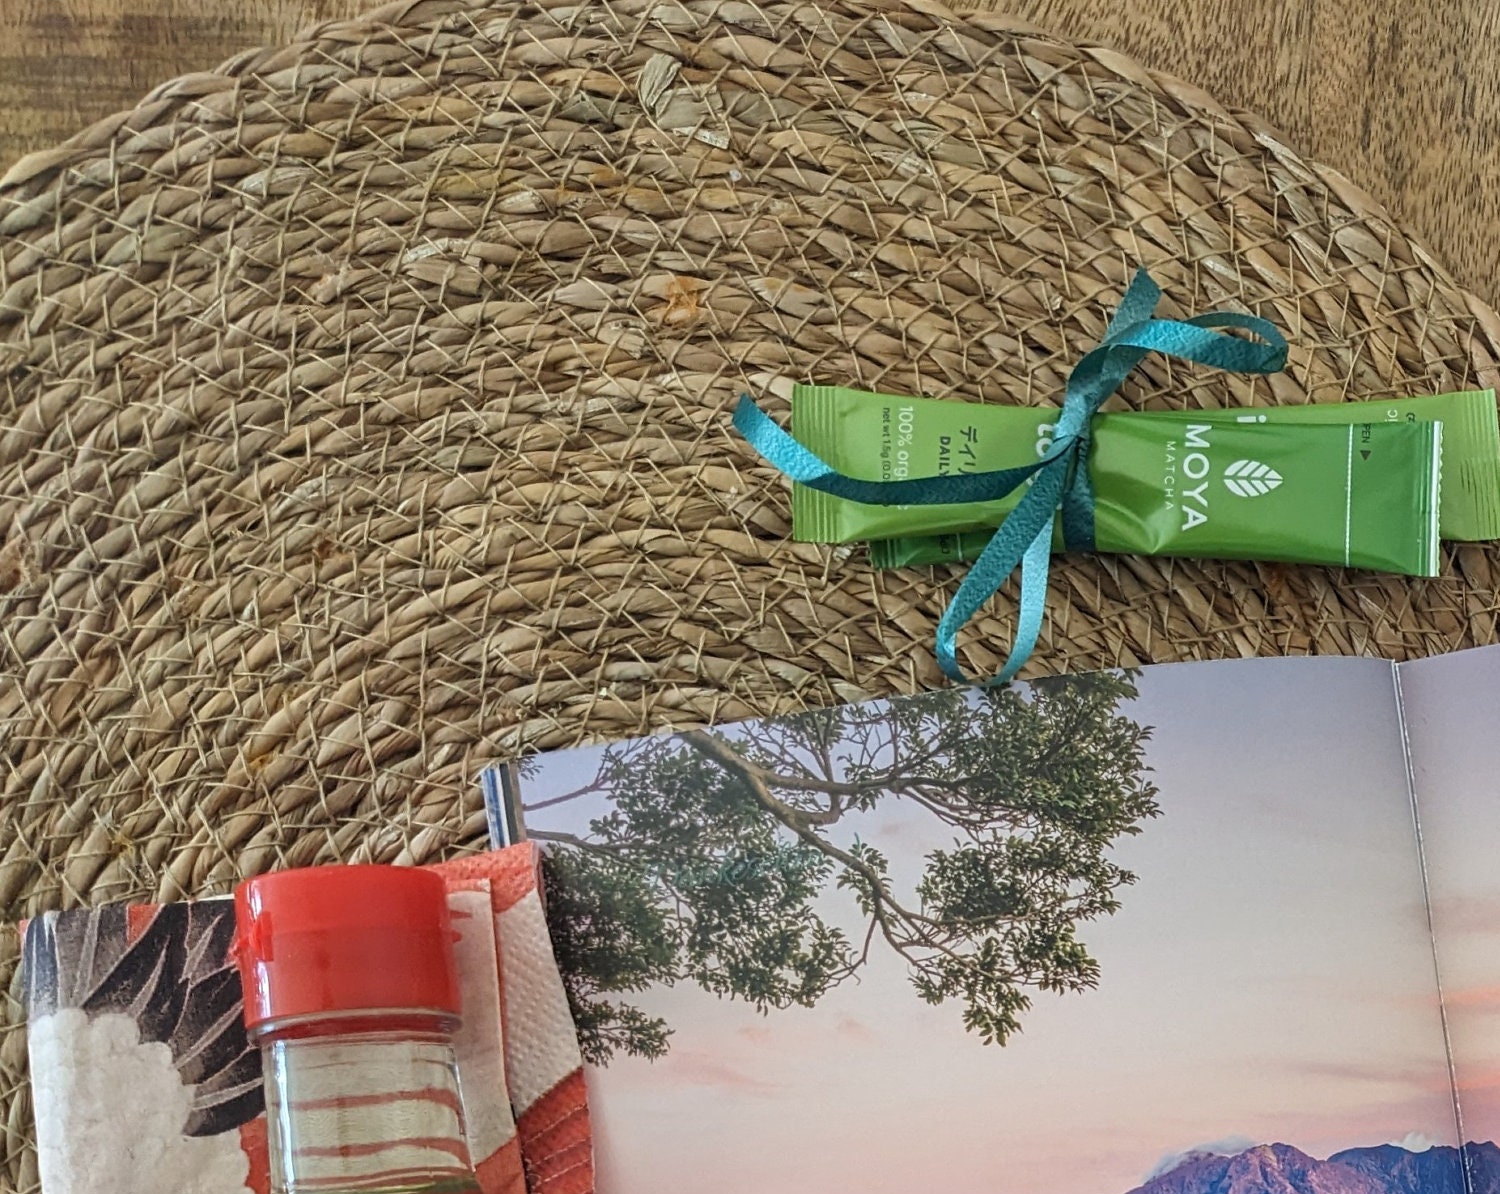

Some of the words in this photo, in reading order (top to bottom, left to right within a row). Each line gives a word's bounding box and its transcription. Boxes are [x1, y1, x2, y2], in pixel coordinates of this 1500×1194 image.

[882, 408, 890, 423] net
[882, 425, 890, 437] wt
[898, 406, 914, 446] 100%
[1361, 423, 1371, 443] PEN
[957, 426, 978, 473] デイリ
[1164, 440, 1177, 511] MATCHA
[1181, 424, 1212, 531] MOYA
